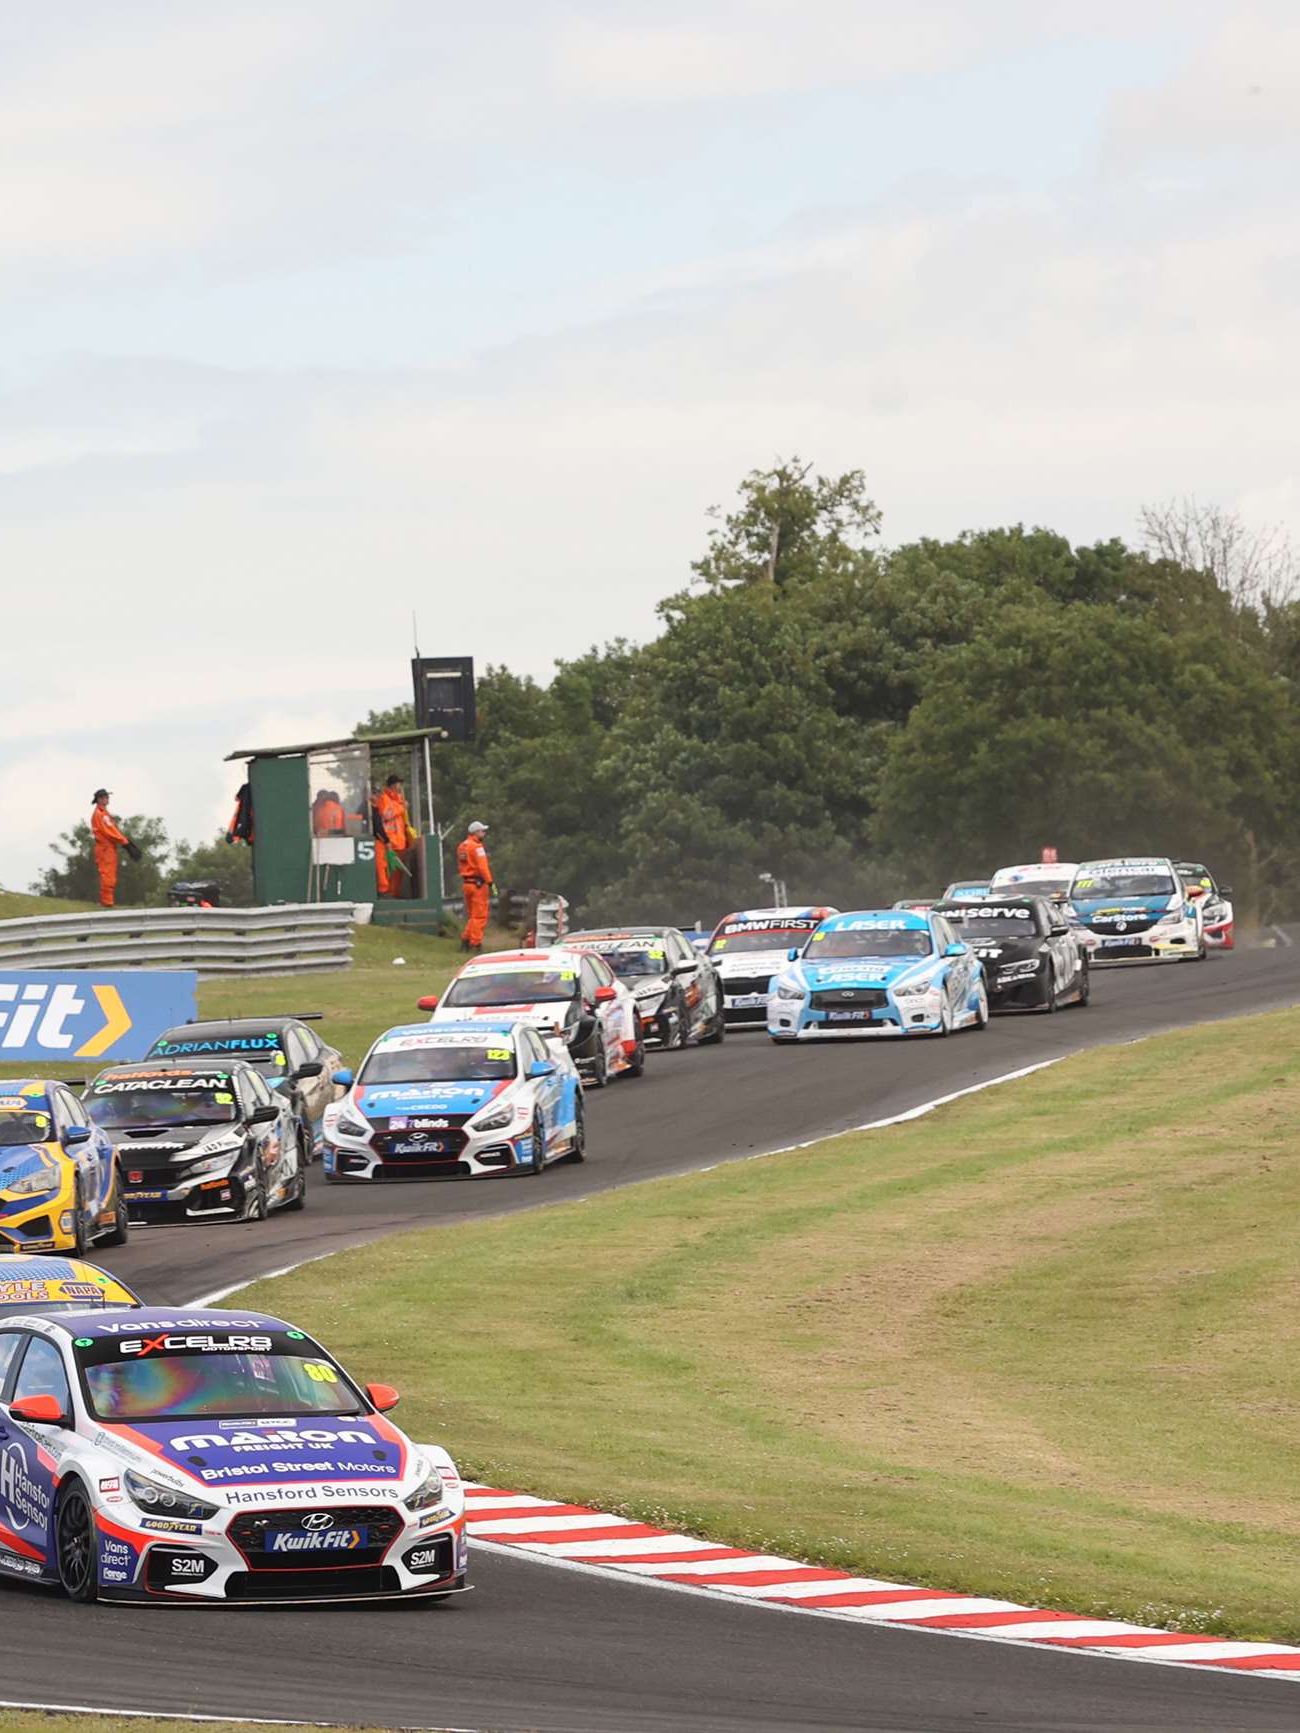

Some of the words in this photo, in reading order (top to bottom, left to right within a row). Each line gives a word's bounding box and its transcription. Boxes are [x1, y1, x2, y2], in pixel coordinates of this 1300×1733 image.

[357, 841, 375, 860] 5
[835, 920, 908, 931] LASER
[94, 1079, 228, 1094] CATACLEAN
[65, 1284, 100, 1296] NAPA
[120, 1333, 272, 1356] EXCELR8
[303, 1363, 338, 1383] 80
[234, 1443, 304, 1453] FREIGHT
[308, 1442, 335, 1450] UK
[200, 1462, 270, 1480] Bristol
[273, 1460, 335, 1473] Street
[338, 1461, 397, 1474] Motors
[225, 1485, 318, 1504] Hansford
[321, 1484, 399, 1499] Sensors
[145, 1519, 198, 1532] GOODYEAR
[104, 1539, 129, 1555] Vans
[100, 1552, 130, 1566] direct
[410, 1549, 436, 1565] S2M
[171, 1558, 205, 1573] S2M
